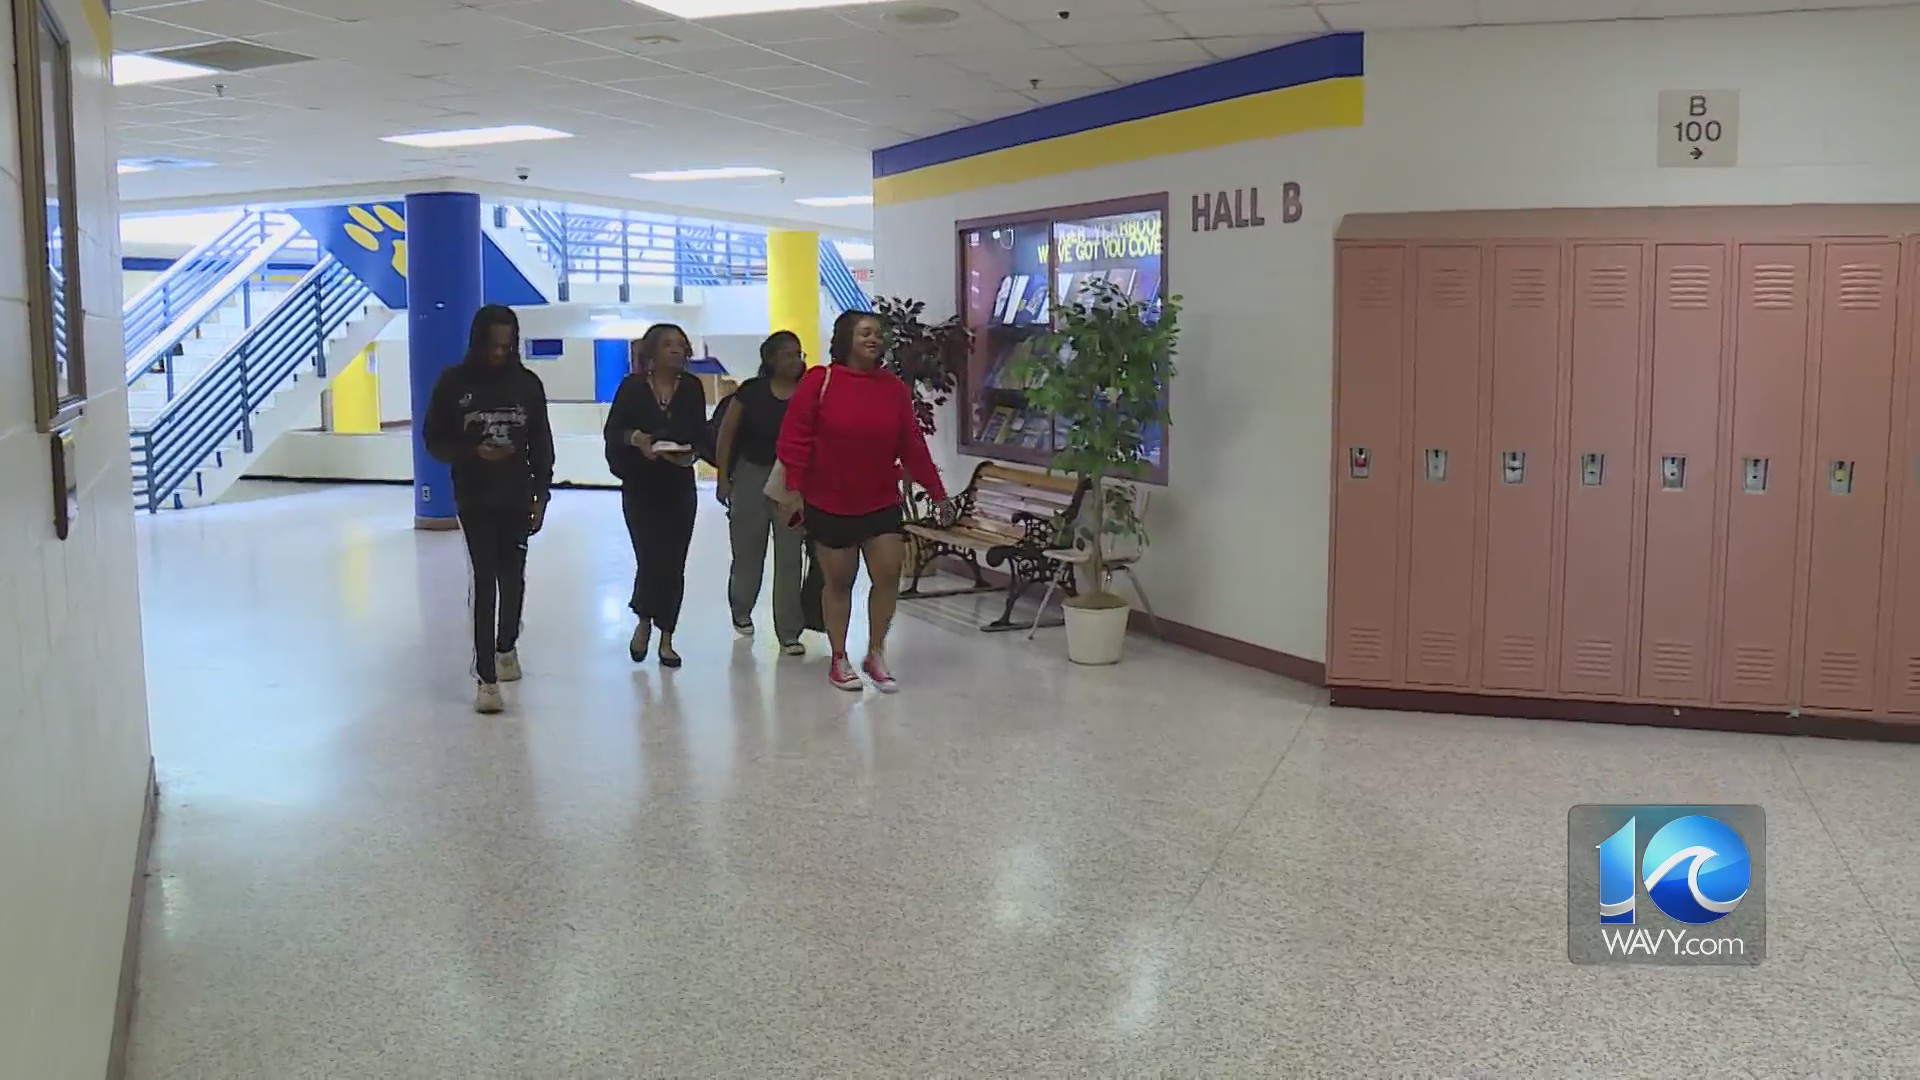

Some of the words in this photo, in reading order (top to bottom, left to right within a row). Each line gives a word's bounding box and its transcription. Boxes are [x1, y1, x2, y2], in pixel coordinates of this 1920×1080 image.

[1690, 95, 1707, 116] B
[1673, 120, 1721, 142] 100
[1192, 187, 1265, 232] HALL
[1283, 181, 1302, 223] B
[1075, 240, 1100, 261] GOT
[1102, 236, 1126, 259] YOU
